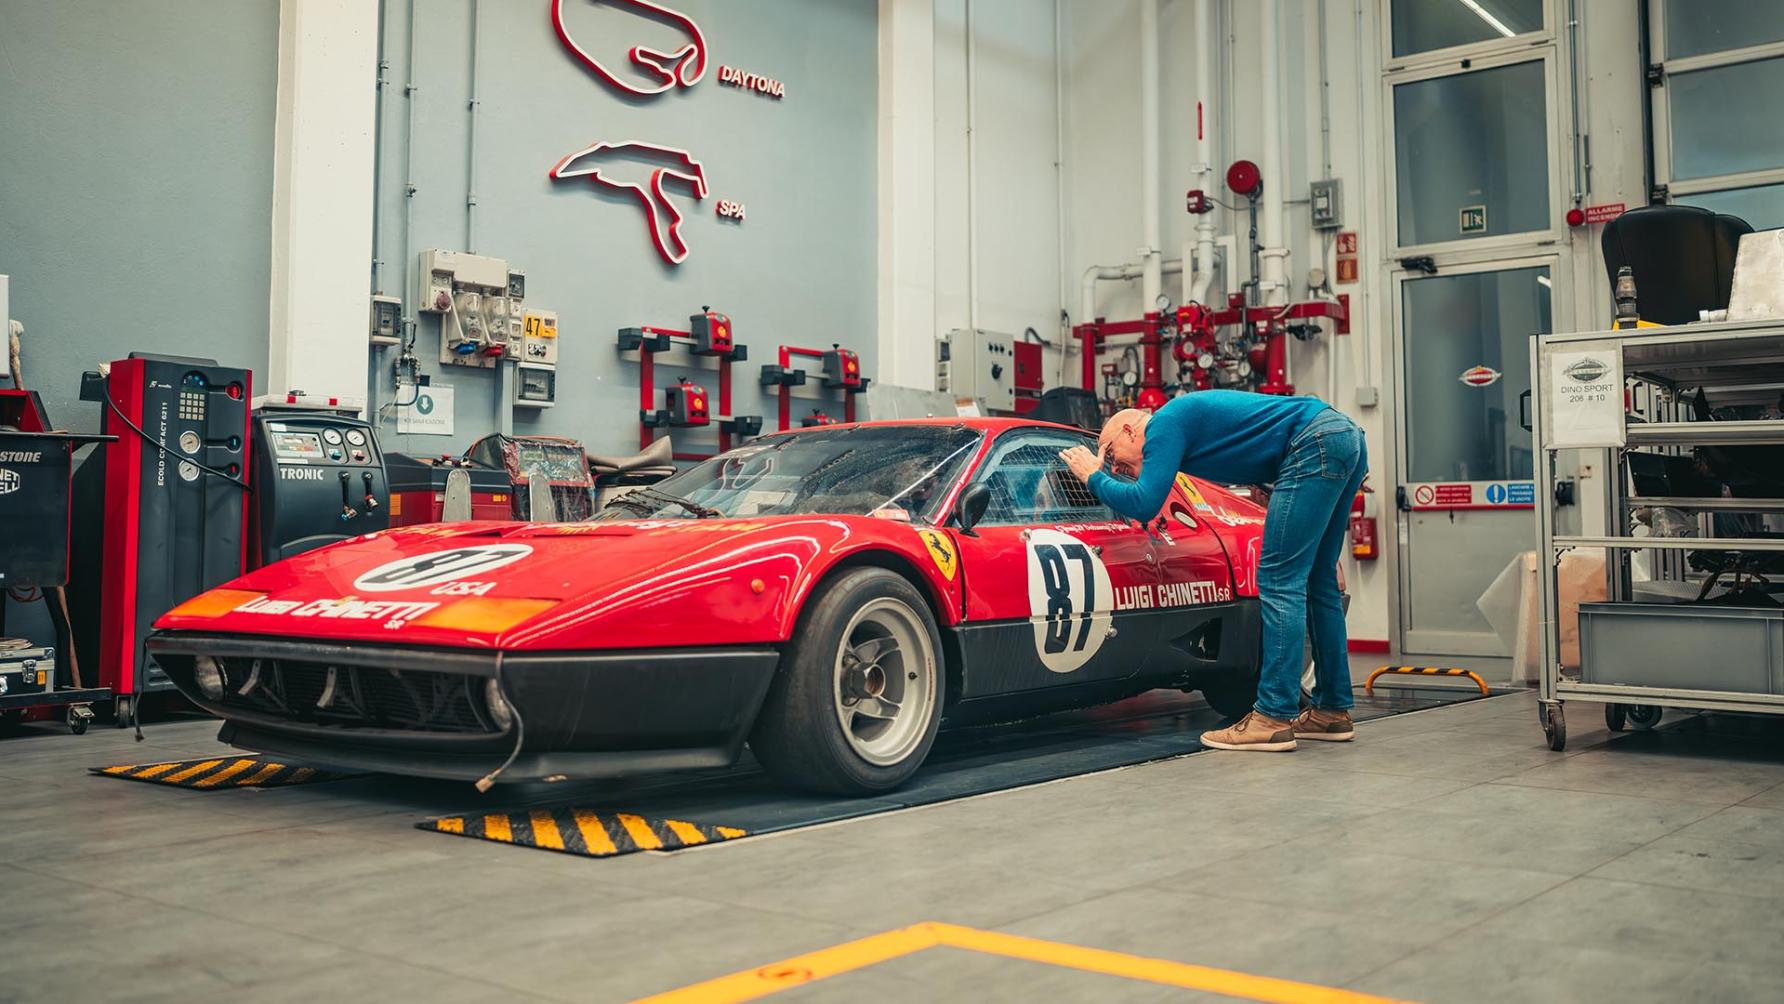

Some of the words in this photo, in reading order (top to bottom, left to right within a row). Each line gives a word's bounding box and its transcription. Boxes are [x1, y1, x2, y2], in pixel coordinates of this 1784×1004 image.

[720, 65, 785, 97] DAYTONA
[718, 200, 745, 219] SPA
[526, 317, 541, 336] 47
[1584, 384, 1613, 393] SPORT
[280, 468, 324, 480] TRONIC
[360, 550, 527, 585] 87
[429, 582, 498, 596] USA
[1115, 585, 1154, 610] LUIGI
[1157, 580, 1217, 608] CHINETTI
[1034, 544, 1095, 654] 87
